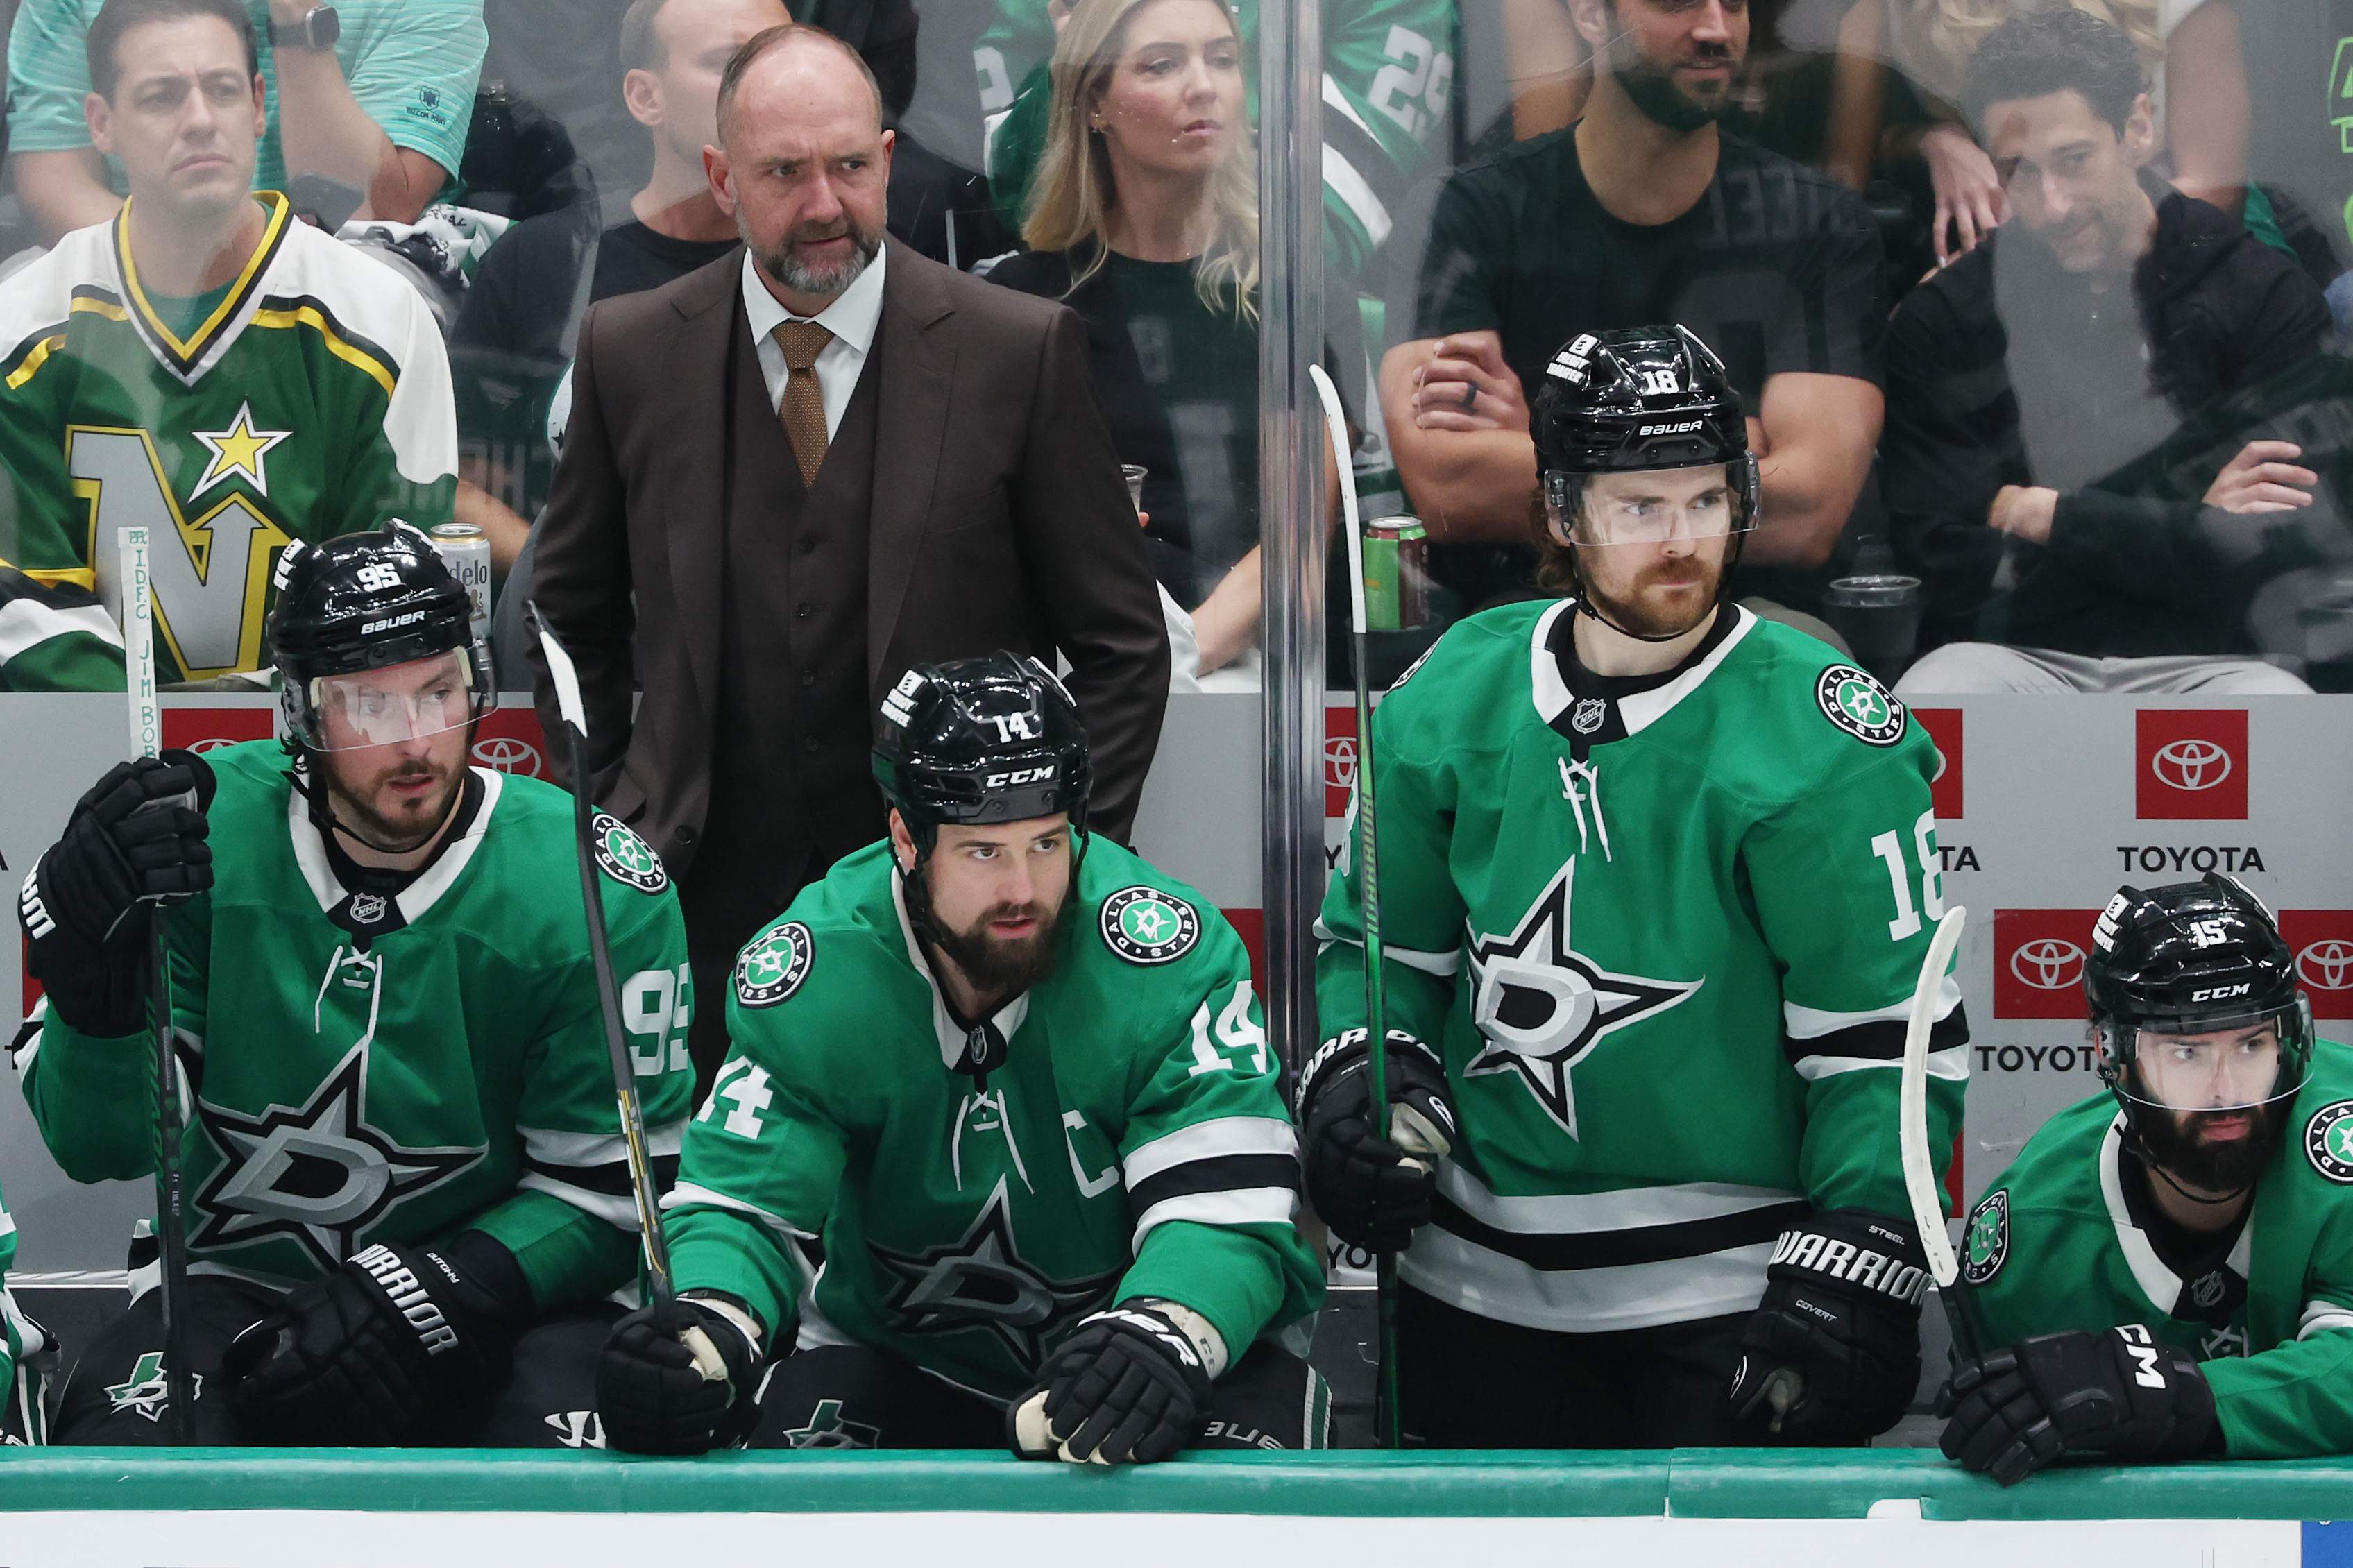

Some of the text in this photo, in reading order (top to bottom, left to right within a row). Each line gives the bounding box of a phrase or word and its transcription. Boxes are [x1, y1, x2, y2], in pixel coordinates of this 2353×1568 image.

[1642, 370, 1680, 396] 18
[1639, 420, 1703, 436] BAUER
[356, 561, 402, 593] 95
[449, 559, 487, 586] delo
[360, 610, 425, 636] BAUER
[1824, 670, 1878, 714] DALLAS
[992, 711, 1033, 744] 14
[1579, 708, 1600, 726] NHL
[1855, 704, 1900, 738] STARS
[986, 765, 1055, 788] CCM
[2117, 846, 2266, 873] TOYOTA
[1108, 891, 1159, 950] DALLAS
[1150, 907, 1194, 957] STARS
[2189, 919, 2227, 947] 15
[766, 927, 805, 982] DALLAS
[2191, 982, 2250, 1003] CCM
[1187, 980, 1267, 1077] 14
[1974, 1045, 2095, 1072] TOYOT
[696, 1055, 774, 1140] 14
[2312, 1107, 2351, 1169] DALLA
[1062, 1110, 1120, 1199] C
[1869, 1224, 1905, 1246] STEEL
[426, 1252, 461, 1284] DUTCHY
[1795, 1298, 1837, 1322] COVERT
[2114, 1323, 2166, 1388] CM
